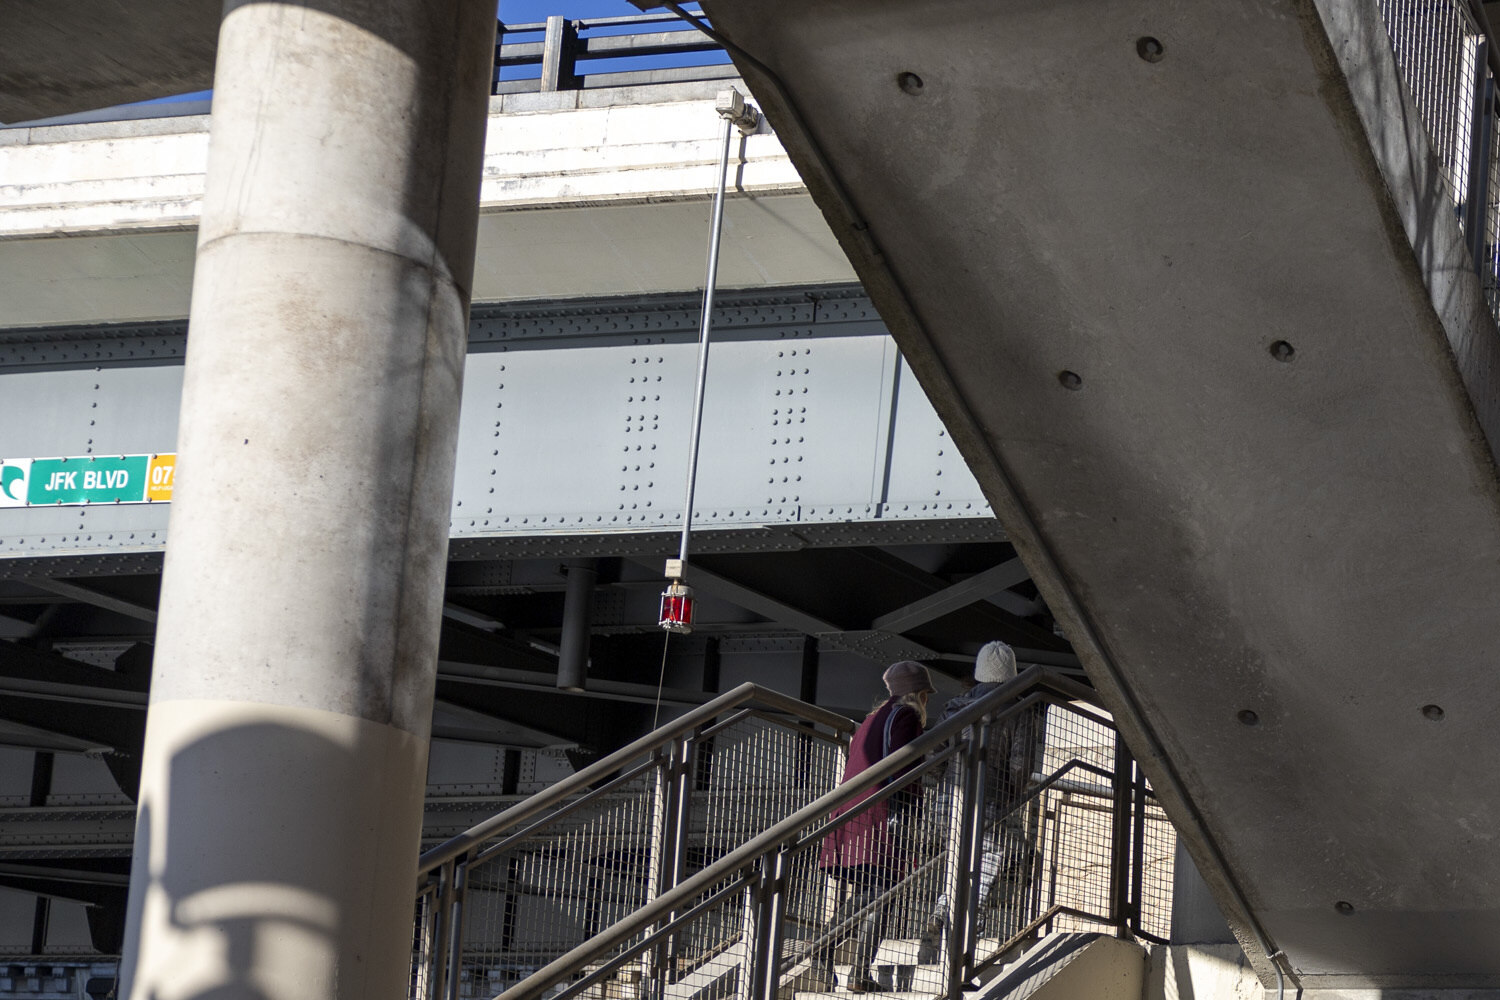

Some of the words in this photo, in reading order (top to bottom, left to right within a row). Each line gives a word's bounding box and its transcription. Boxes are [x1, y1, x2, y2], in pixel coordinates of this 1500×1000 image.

[45, 471, 77, 491] JFK
[83, 470, 129, 489] BLVD
[152, 465, 175, 485] 07
